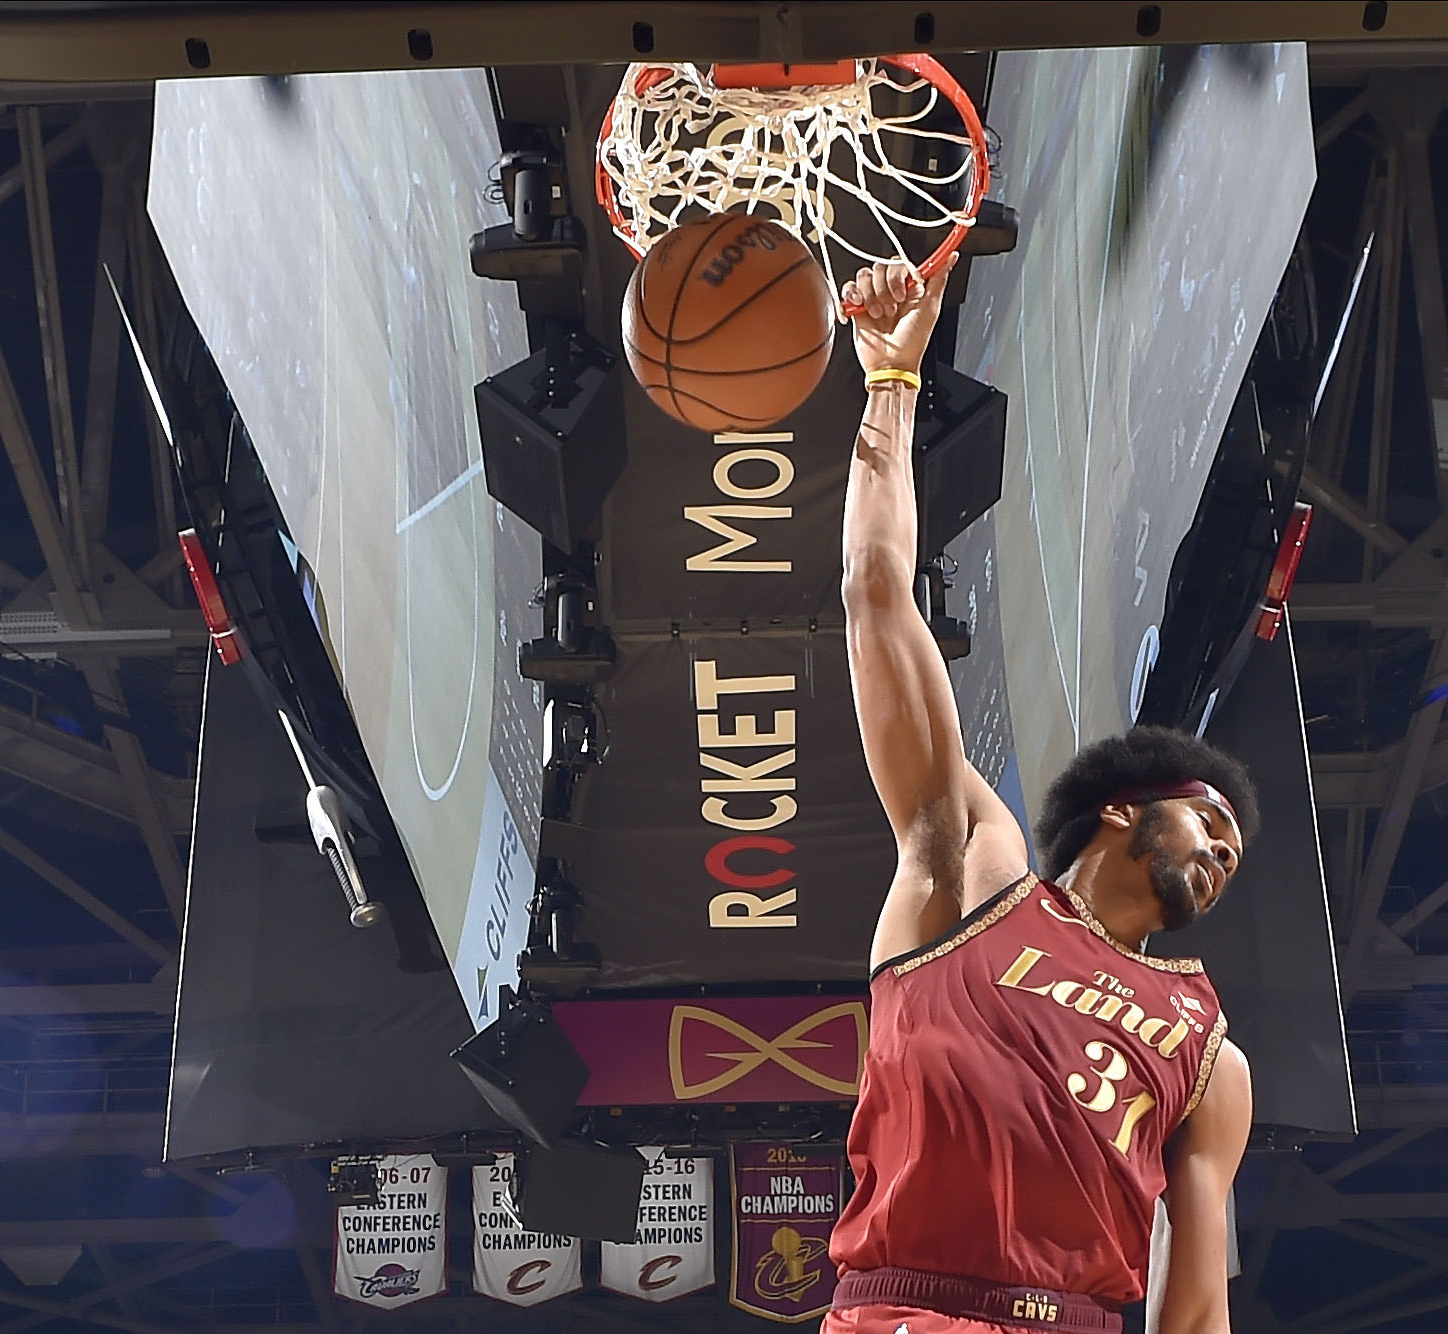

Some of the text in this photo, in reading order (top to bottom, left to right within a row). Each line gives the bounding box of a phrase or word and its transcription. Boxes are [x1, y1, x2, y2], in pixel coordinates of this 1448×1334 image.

[695, 659, 798, 929] ROCKET
[486, 811, 518, 961] CLIFFS
[1093, 970, 1137, 999] The
[995, 945, 1191, 1059] Land
[1169, 995, 1205, 1034] CLIFFS
[1066, 1040, 1157, 1162] 31
[642, 1184, 692, 1200] STERN
[770, 1176, 804, 1195] NBA
[639, 1205, 707, 1222] FERENCE
[741, 1194, 834, 1214] CHAMPIONS
[343, 1213, 441, 1232] CONFERENCE
[346, 1235, 436, 1254] CHAMPIONS
[482, 1233, 572, 1250] CHAMPIONS
[636, 1227, 703, 1245] AMPIONS
[1012, 1300, 1058, 1324] CAVS
